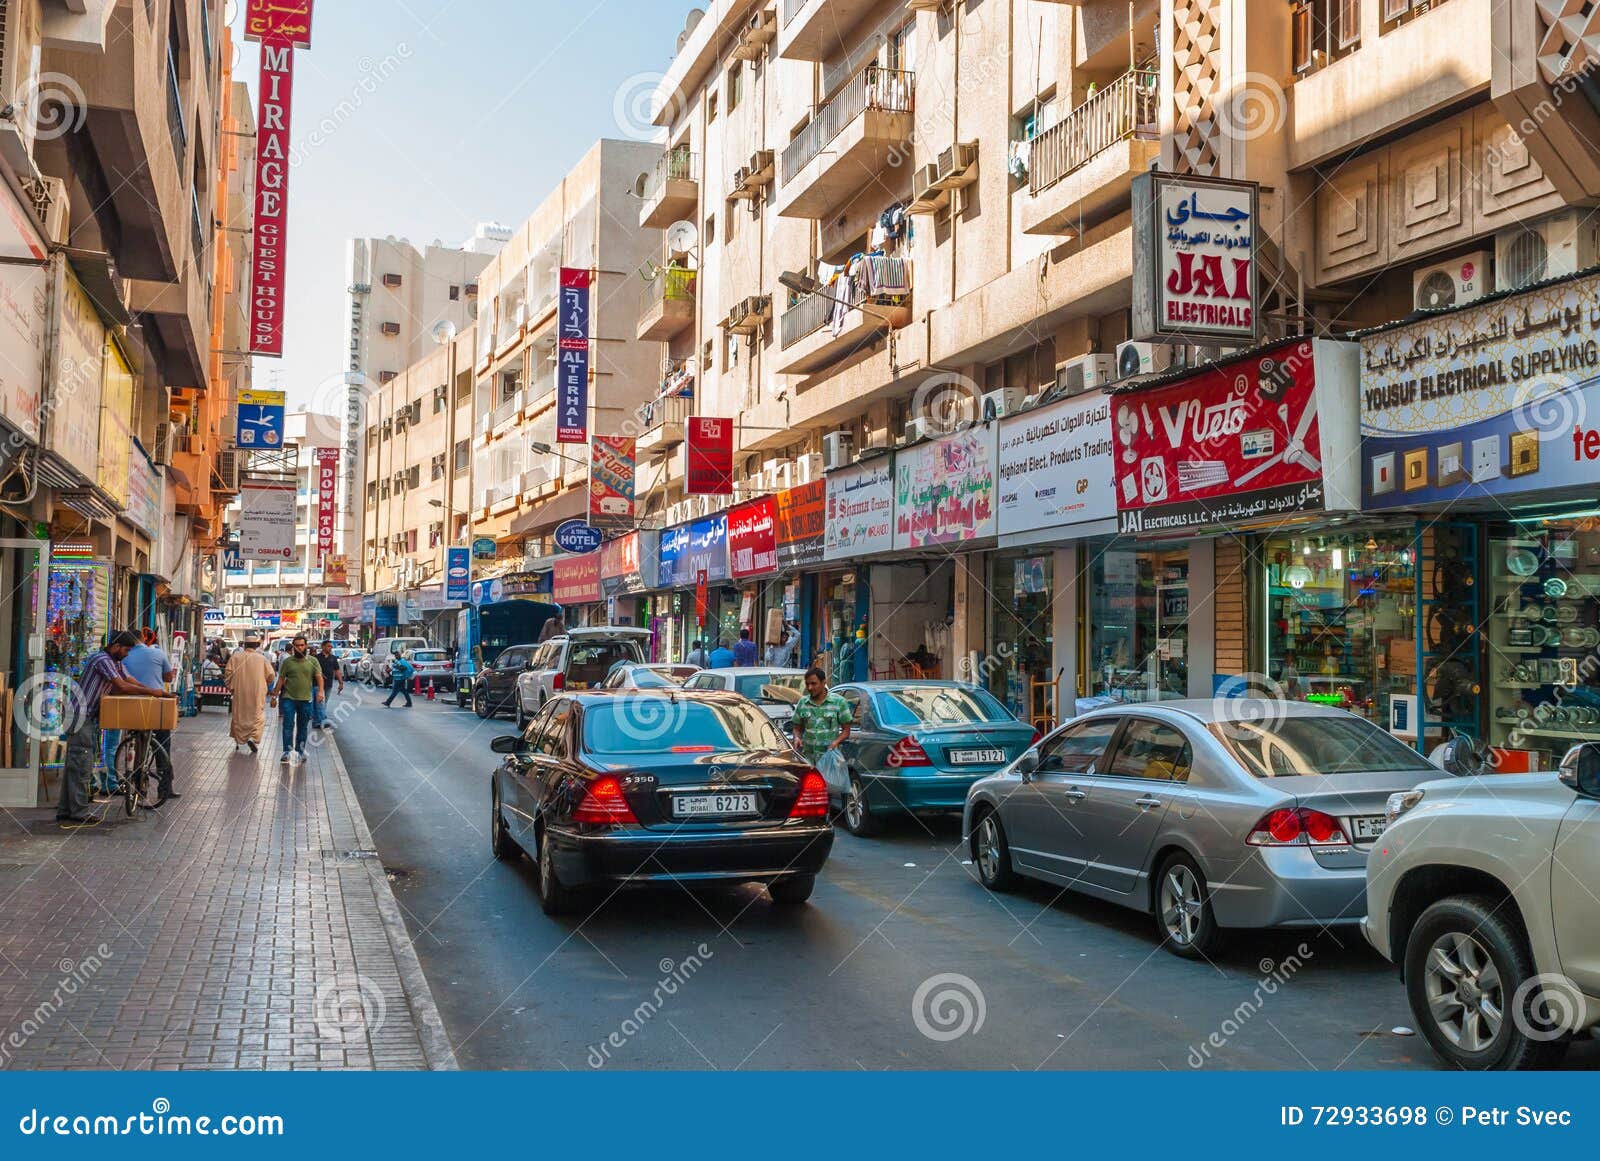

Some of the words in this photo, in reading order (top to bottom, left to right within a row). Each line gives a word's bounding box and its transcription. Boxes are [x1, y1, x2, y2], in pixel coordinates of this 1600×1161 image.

[260, 45, 290, 217] MIRAGE
[258, 225, 279, 281] GUEST
[1167, 251, 1252, 301] JAI
[1462, 283, 1473, 293] LG
[256, 286, 277, 345] HOUSE
[1167, 300, 1252, 328] ELECTRICALS
[562, 351, 585, 364] AL
[1365, 379, 1417, 412] YOUSUF
[1420, 359, 1507, 401] ELECTRICAL
[1510, 339, 1597, 380] SUPPLYING
[566, 364, 579, 427] TERHAL
[1187, 391, 1247, 443] Veto
[1000, 459, 1028, 481] Highland
[1028, 456, 1048, 472] Elect.
[1049, 446, 1082, 467] Products
[1083, 438, 1113, 459] Trading
[321, 468, 333, 511] DOWN
[1120, 509, 1143, 534] JAI
[1144, 512, 1188, 530] ELECTRICALS
[1188, 510, 1209, 525] L.L.C.
[561, 535, 597, 545] HOTEL
[976, 750, 1003, 761] 15127
[678, 798, 685, 812] E
[716, 796, 750, 812] 6273
[1358, 820, 1366, 835] F
